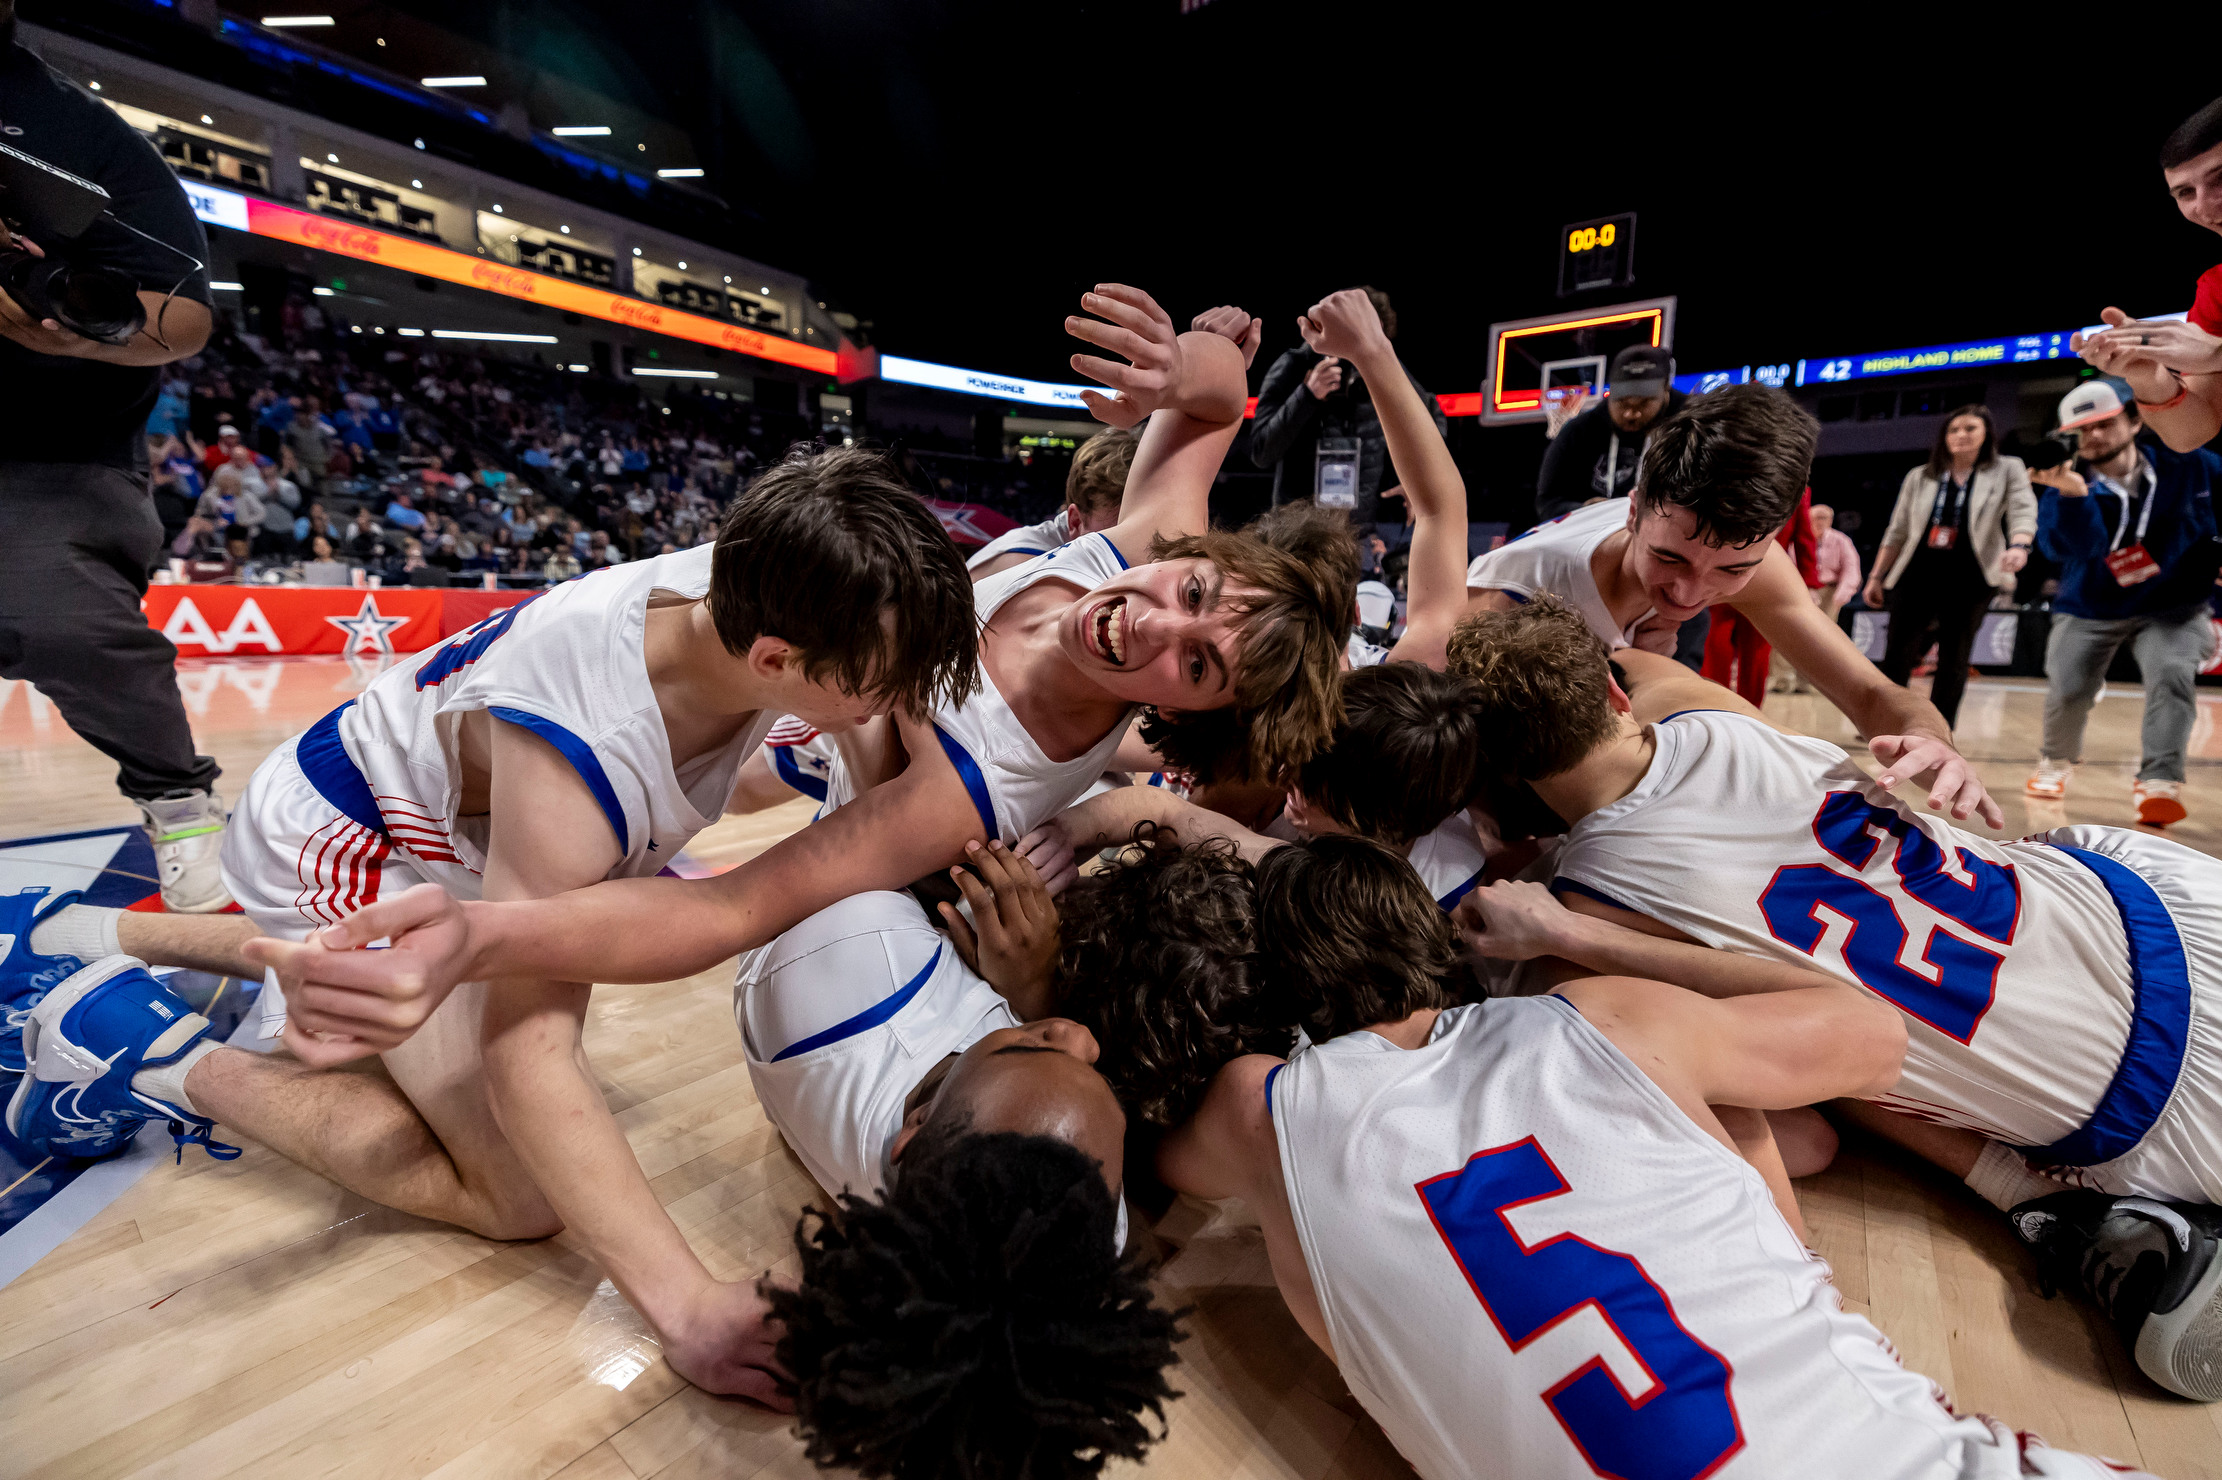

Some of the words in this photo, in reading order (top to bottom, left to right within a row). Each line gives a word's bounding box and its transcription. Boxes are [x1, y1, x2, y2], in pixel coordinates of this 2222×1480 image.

[1818, 359, 1853, 382] 42
[1862, 350, 1949, 373] HIGHLAND
[1950, 344, 2005, 364] HOME
[1757, 790, 2022, 1046] 22
[1413, 1134, 1747, 1480] 5
